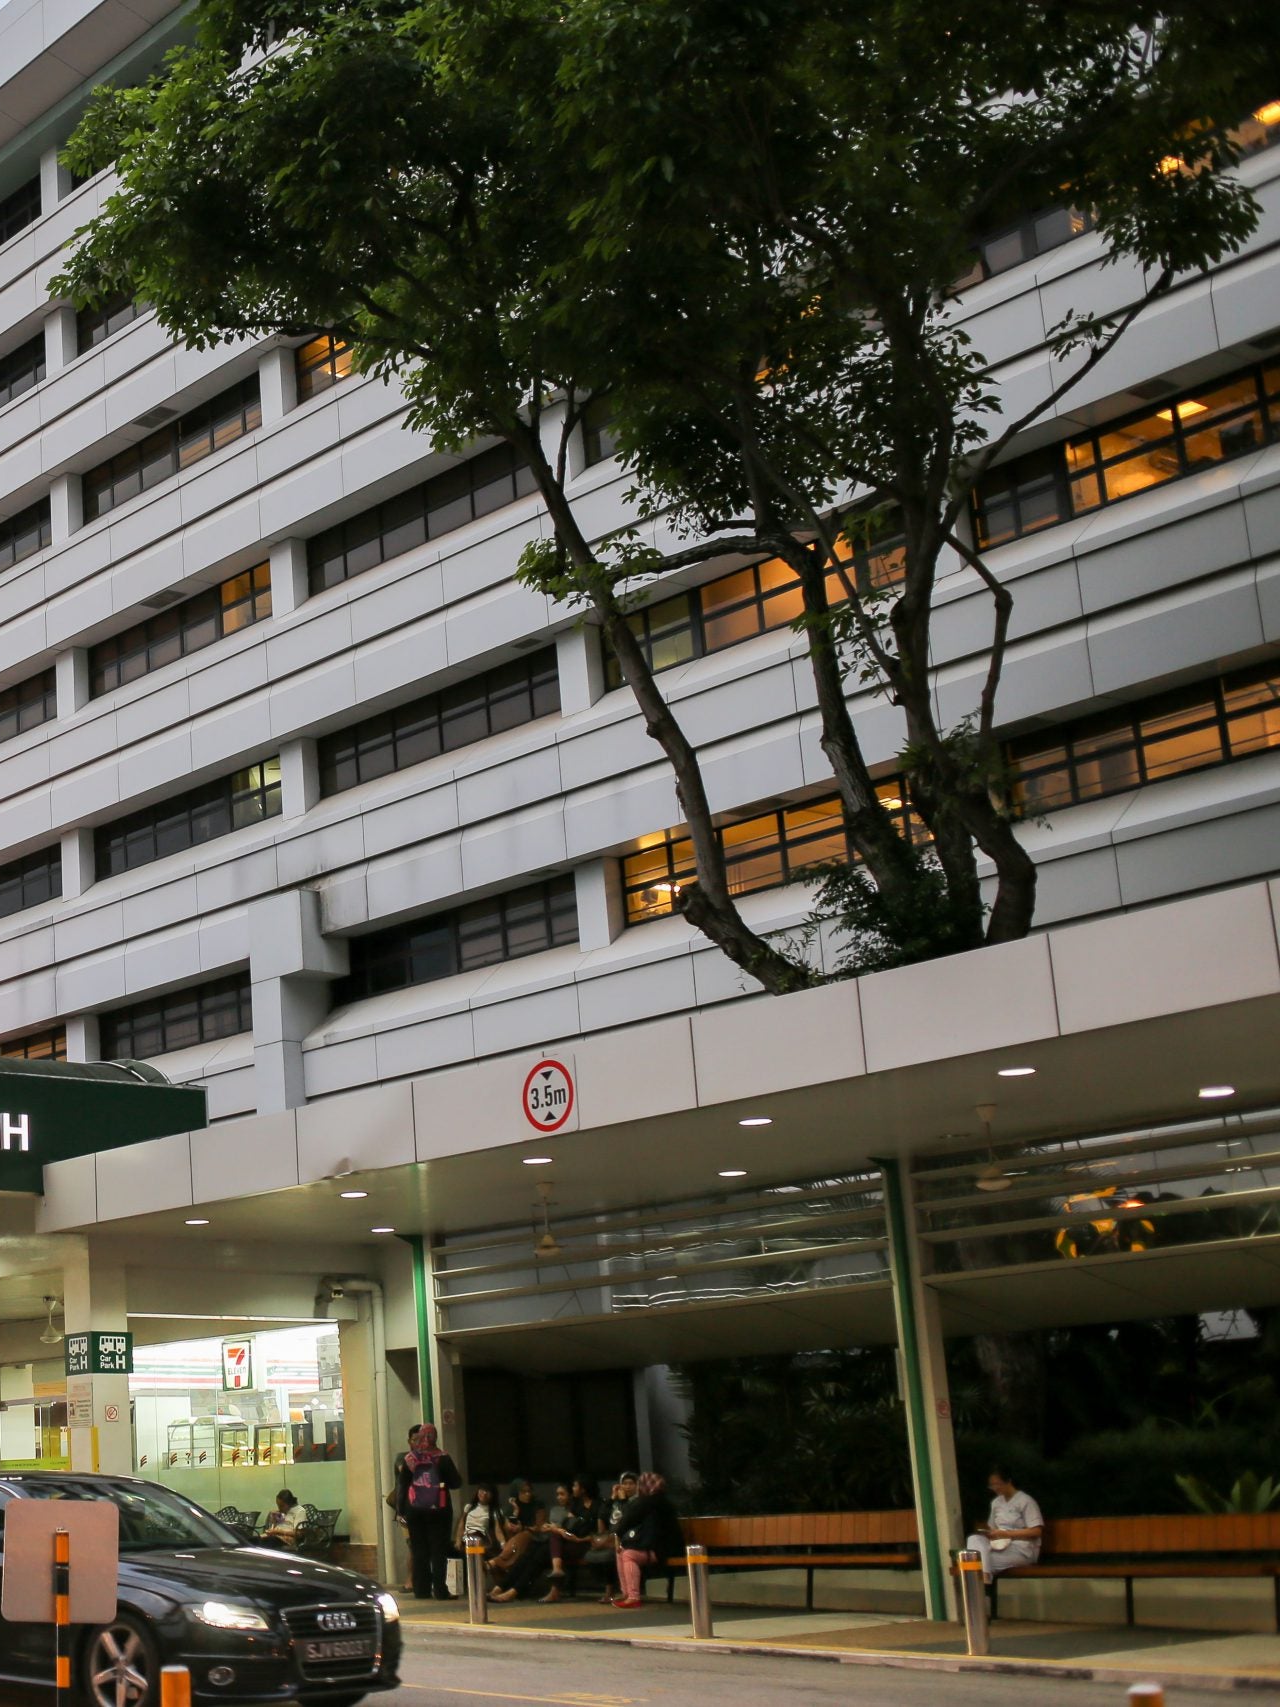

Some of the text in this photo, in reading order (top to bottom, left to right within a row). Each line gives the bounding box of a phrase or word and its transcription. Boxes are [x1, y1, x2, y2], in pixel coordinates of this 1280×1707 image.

[530, 1085, 567, 1109] 3.5m
[80, 1355, 88, 1370] H
[115, 1355, 126, 1369] H
